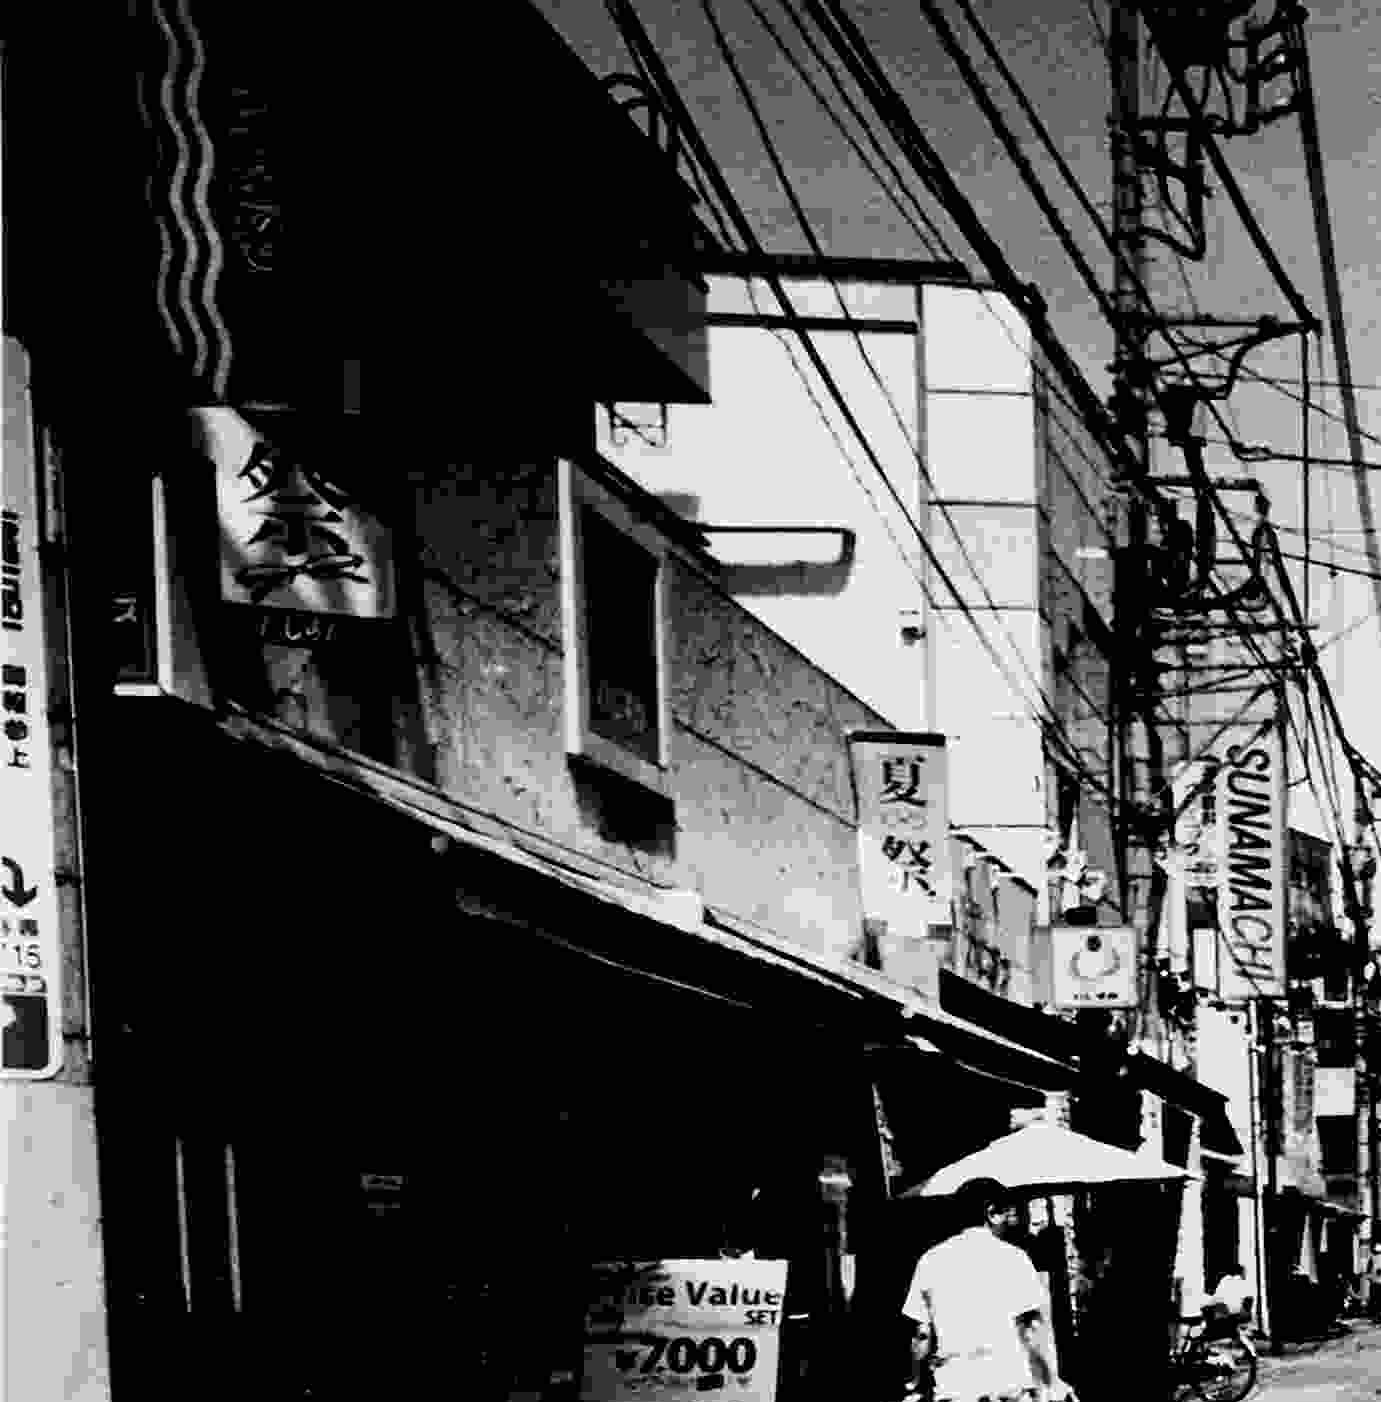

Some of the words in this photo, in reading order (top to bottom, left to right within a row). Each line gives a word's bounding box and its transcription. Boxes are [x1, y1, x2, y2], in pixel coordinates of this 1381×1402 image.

[1226, 743, 1273, 984] SUNAMACHI
[686, 1281, 781, 1305] Value
[744, 1309, 779, 1325] SET
